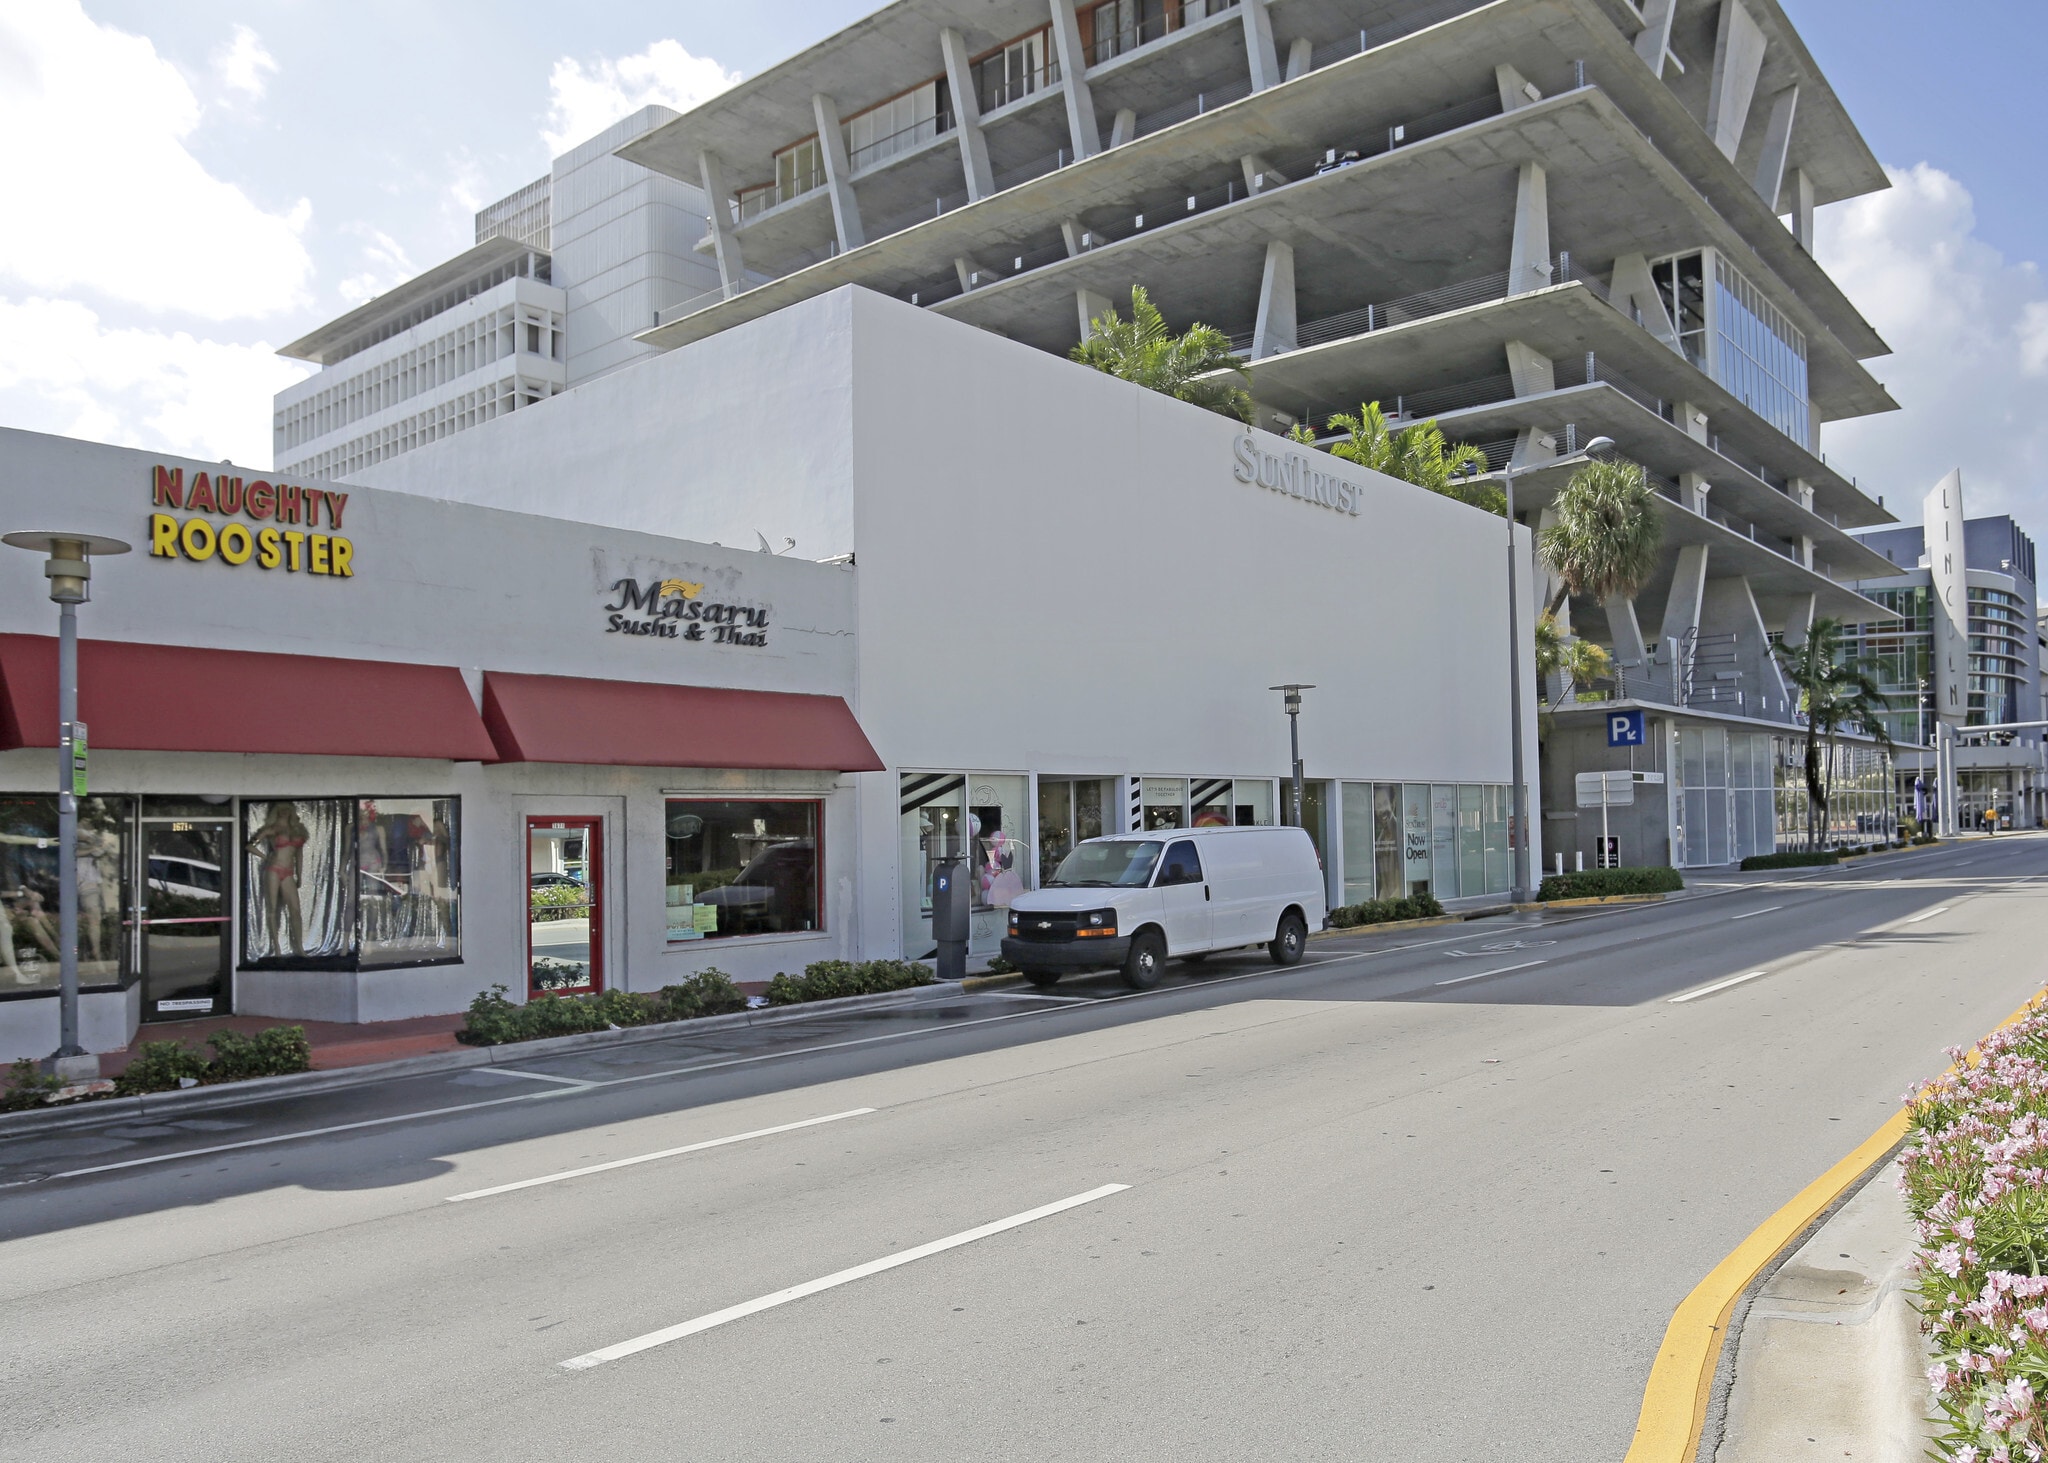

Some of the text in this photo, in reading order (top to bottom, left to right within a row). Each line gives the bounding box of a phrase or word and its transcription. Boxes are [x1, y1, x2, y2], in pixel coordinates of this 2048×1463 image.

[153, 464, 349, 530] NAUGHTY
[150, 512, 354, 577] ROOSTER
[604, 578, 770, 628] Masaru
[1942, 488, 1958, 706] LINCOLN
[605, 613, 769, 648] Sushi & Thai
[1612, 716, 1631, 742] P
[1407, 832, 1426, 846] Now
[939, 878, 947, 889] P
